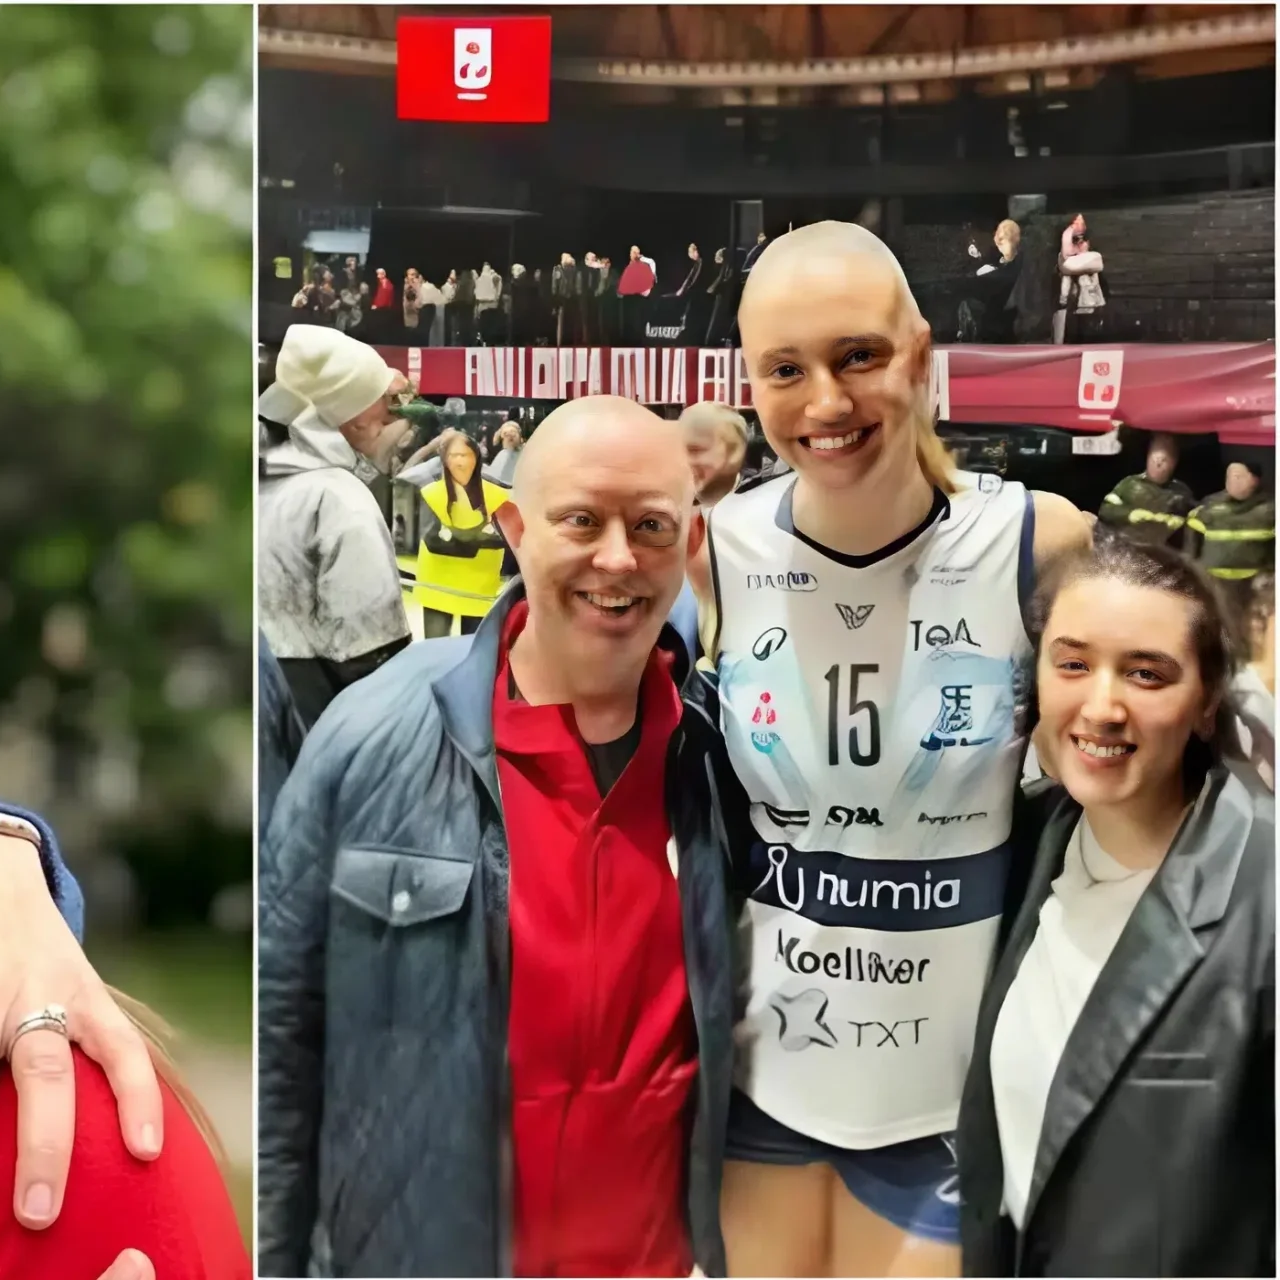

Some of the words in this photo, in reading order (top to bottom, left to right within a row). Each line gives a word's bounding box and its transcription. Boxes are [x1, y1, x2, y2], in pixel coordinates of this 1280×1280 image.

[824, 663, 881, 767] 15
[817, 870, 961, 910] numia
[848, 1017, 930, 1048] TXT
